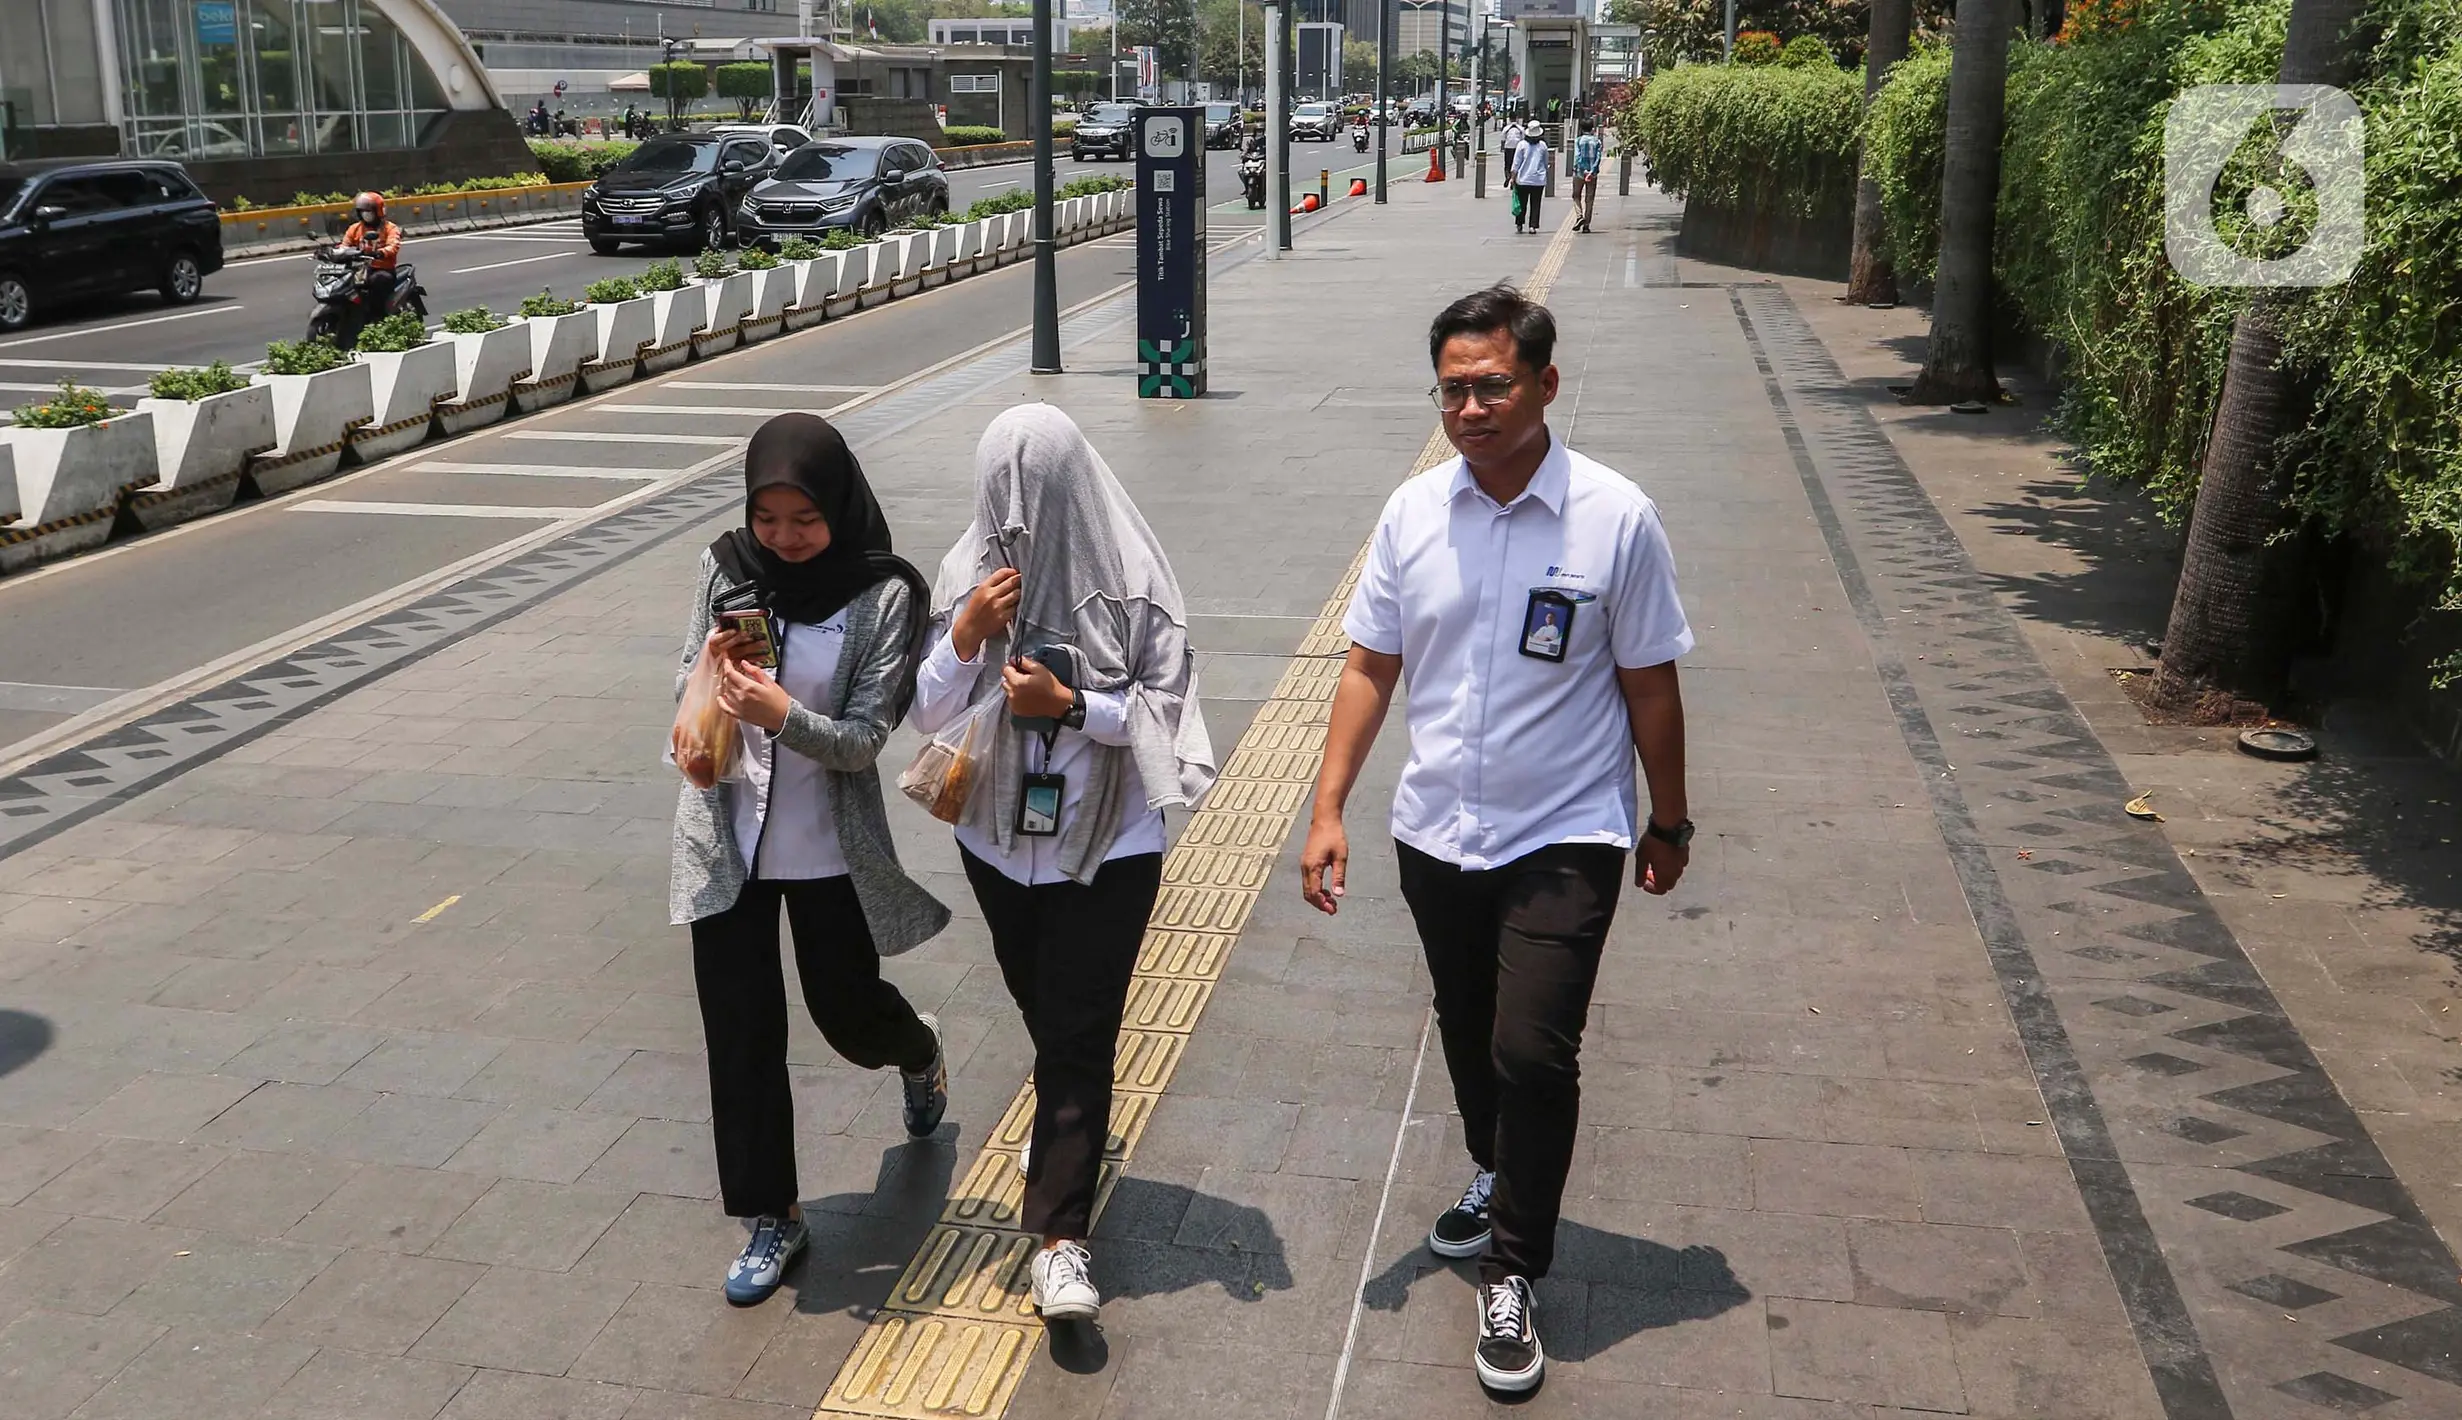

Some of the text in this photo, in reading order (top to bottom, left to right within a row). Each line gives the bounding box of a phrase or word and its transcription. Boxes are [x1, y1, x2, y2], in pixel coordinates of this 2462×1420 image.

[1157, 215, 1165, 240] Sepeda
[1157, 240, 1165, 265] Tambat
[1157, 266, 1165, 281] Titik
